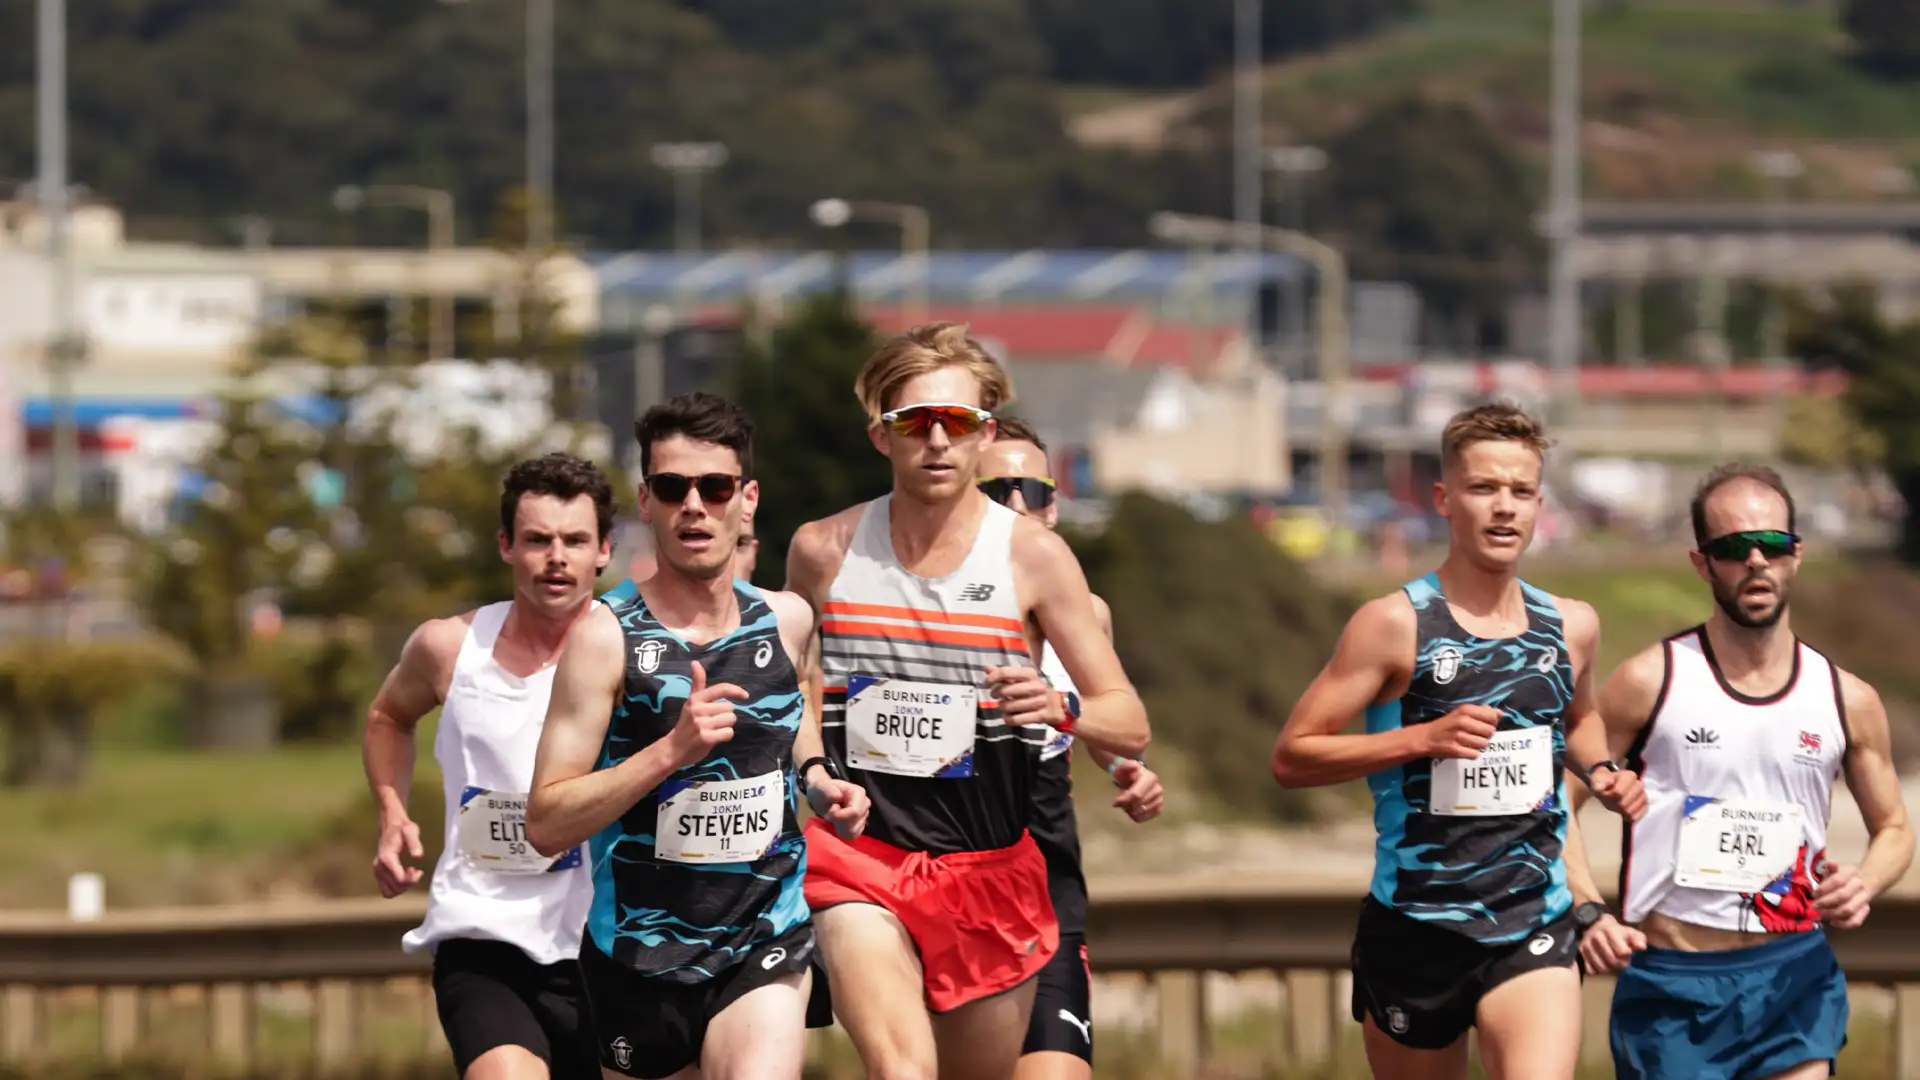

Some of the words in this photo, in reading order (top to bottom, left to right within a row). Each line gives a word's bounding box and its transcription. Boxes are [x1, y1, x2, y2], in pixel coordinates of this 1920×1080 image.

[895, 706, 923, 715] 10KM
[876, 713, 942, 740] BRUCE
[905, 740, 909, 752] 1
[1478, 739, 1532, 753] RNIE10
[1464, 764, 1527, 788] HEYNE
[701, 786, 766, 801] BURNIE10
[1493, 790, 1501, 800] 4
[712, 805, 741, 814] 10KM
[678, 809, 768, 836] STEVENS
[490, 821, 527, 841] ELIT
[509, 843, 525, 854] 50
[720, 838, 730, 850] 11
[1719, 832, 1766, 856] EARL
[1738, 857, 1746, 868] 9
